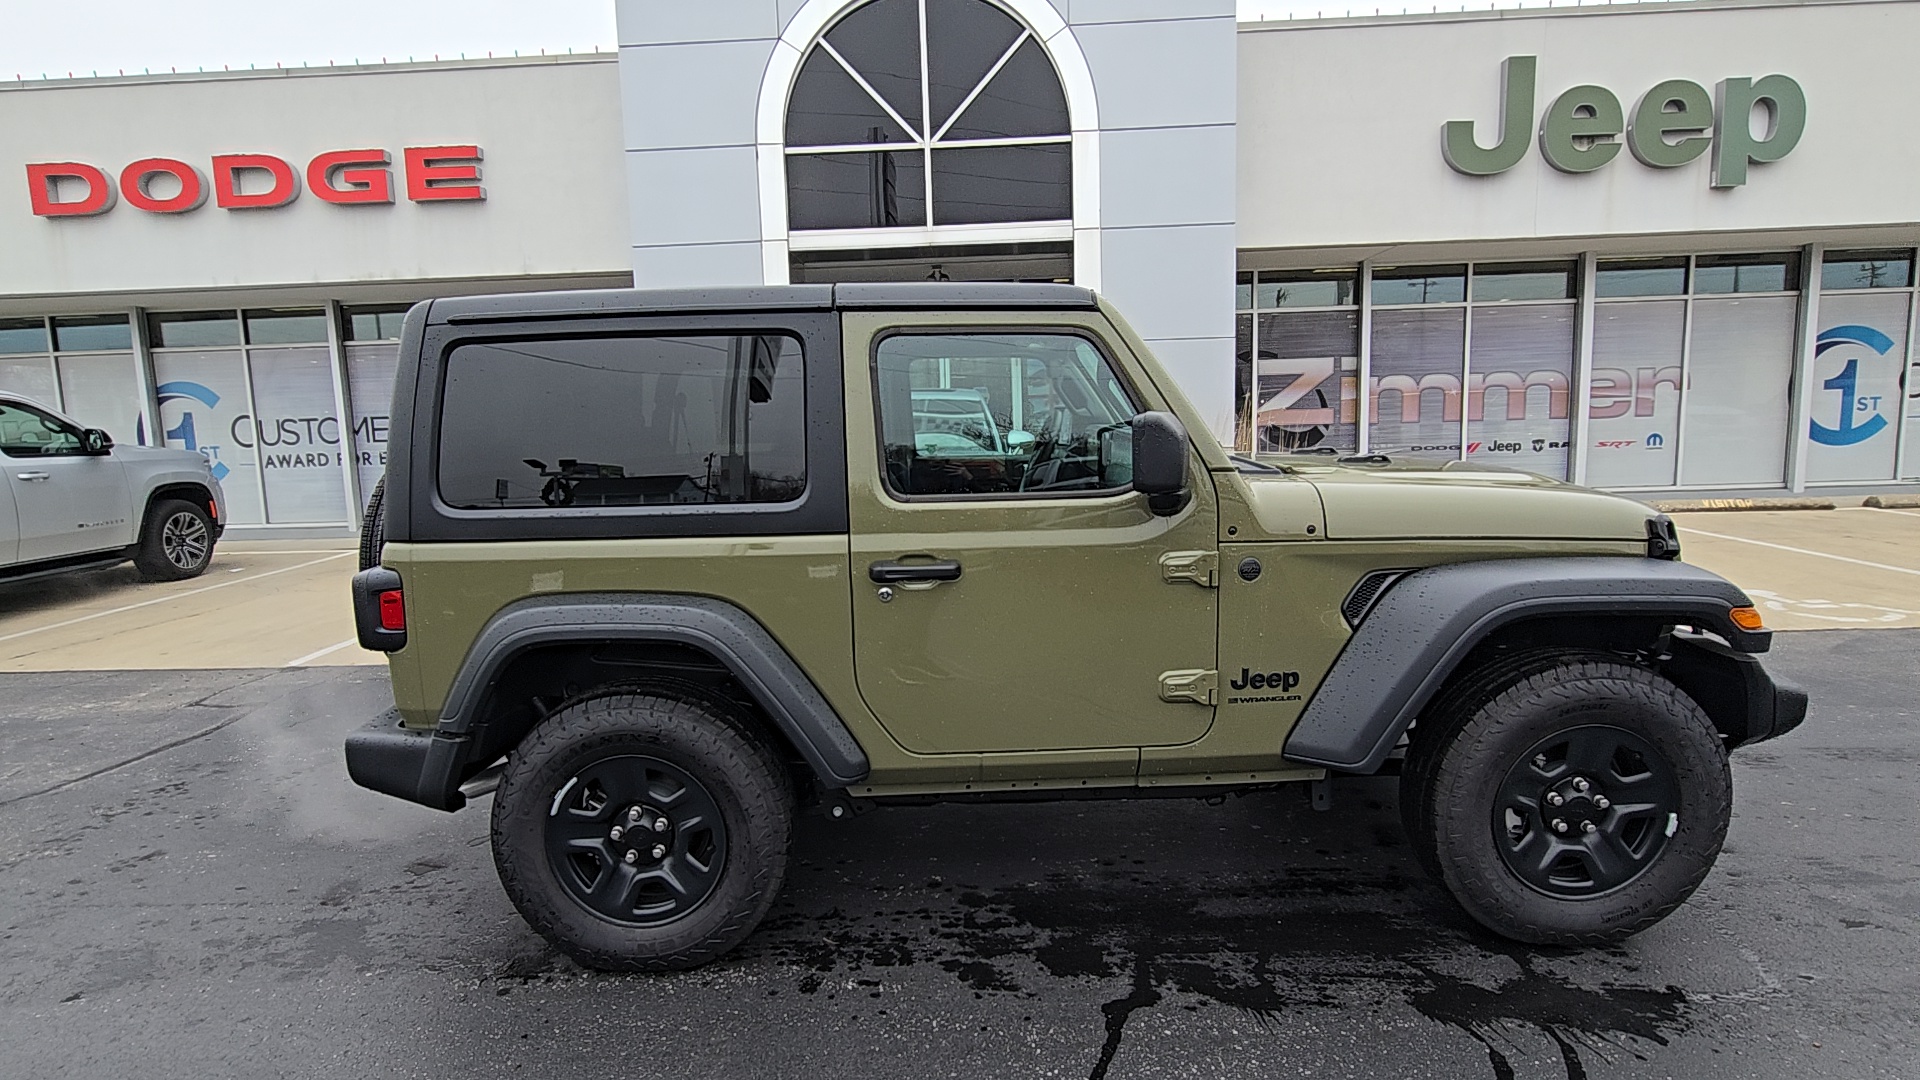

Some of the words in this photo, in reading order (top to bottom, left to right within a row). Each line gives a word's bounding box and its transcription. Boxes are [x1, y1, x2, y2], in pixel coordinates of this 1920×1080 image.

[1441, 55, 1807, 190] Jeep
[25, 145, 487, 218] DODGE
[1257, 356, 1691, 427] Zimmer
[231, 414, 390, 448] CUSTOME
[1487, 440, 1522, 454] Jeep
[1549, 441, 1569, 449] RA
[1594, 440, 1637, 448] SRT
[264, 453, 330, 469] AWARD
[1701, 498, 1754, 508] VISITOR
[1230, 667, 1300, 692] Jeep
[1240, 695, 1302, 703] WRANGLER
